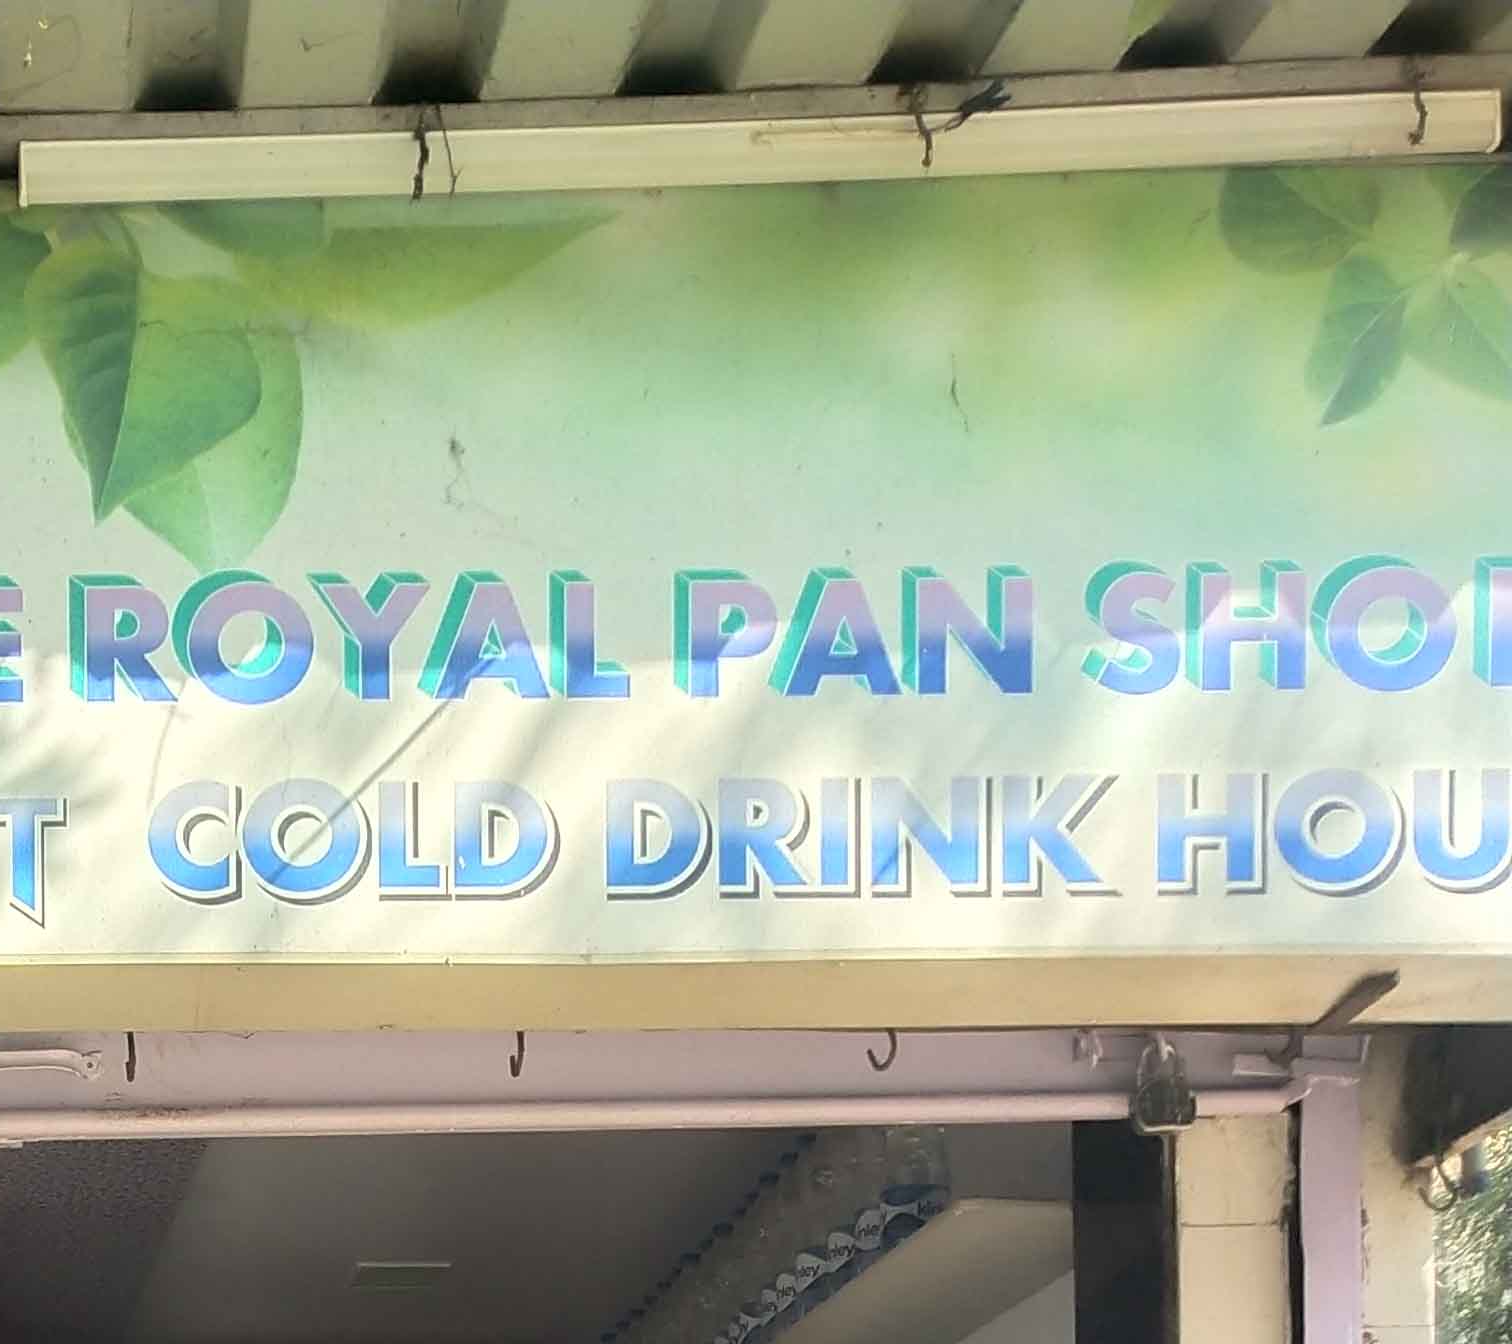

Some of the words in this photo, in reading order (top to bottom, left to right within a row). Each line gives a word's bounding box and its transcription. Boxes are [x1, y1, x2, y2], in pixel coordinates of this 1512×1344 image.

[70, 568, 632, 705] ROYAL
[673, 565, 1035, 698] PAN
[146, 780, 561, 907] COLD
[604, 774, 1123, 901] DRINK
